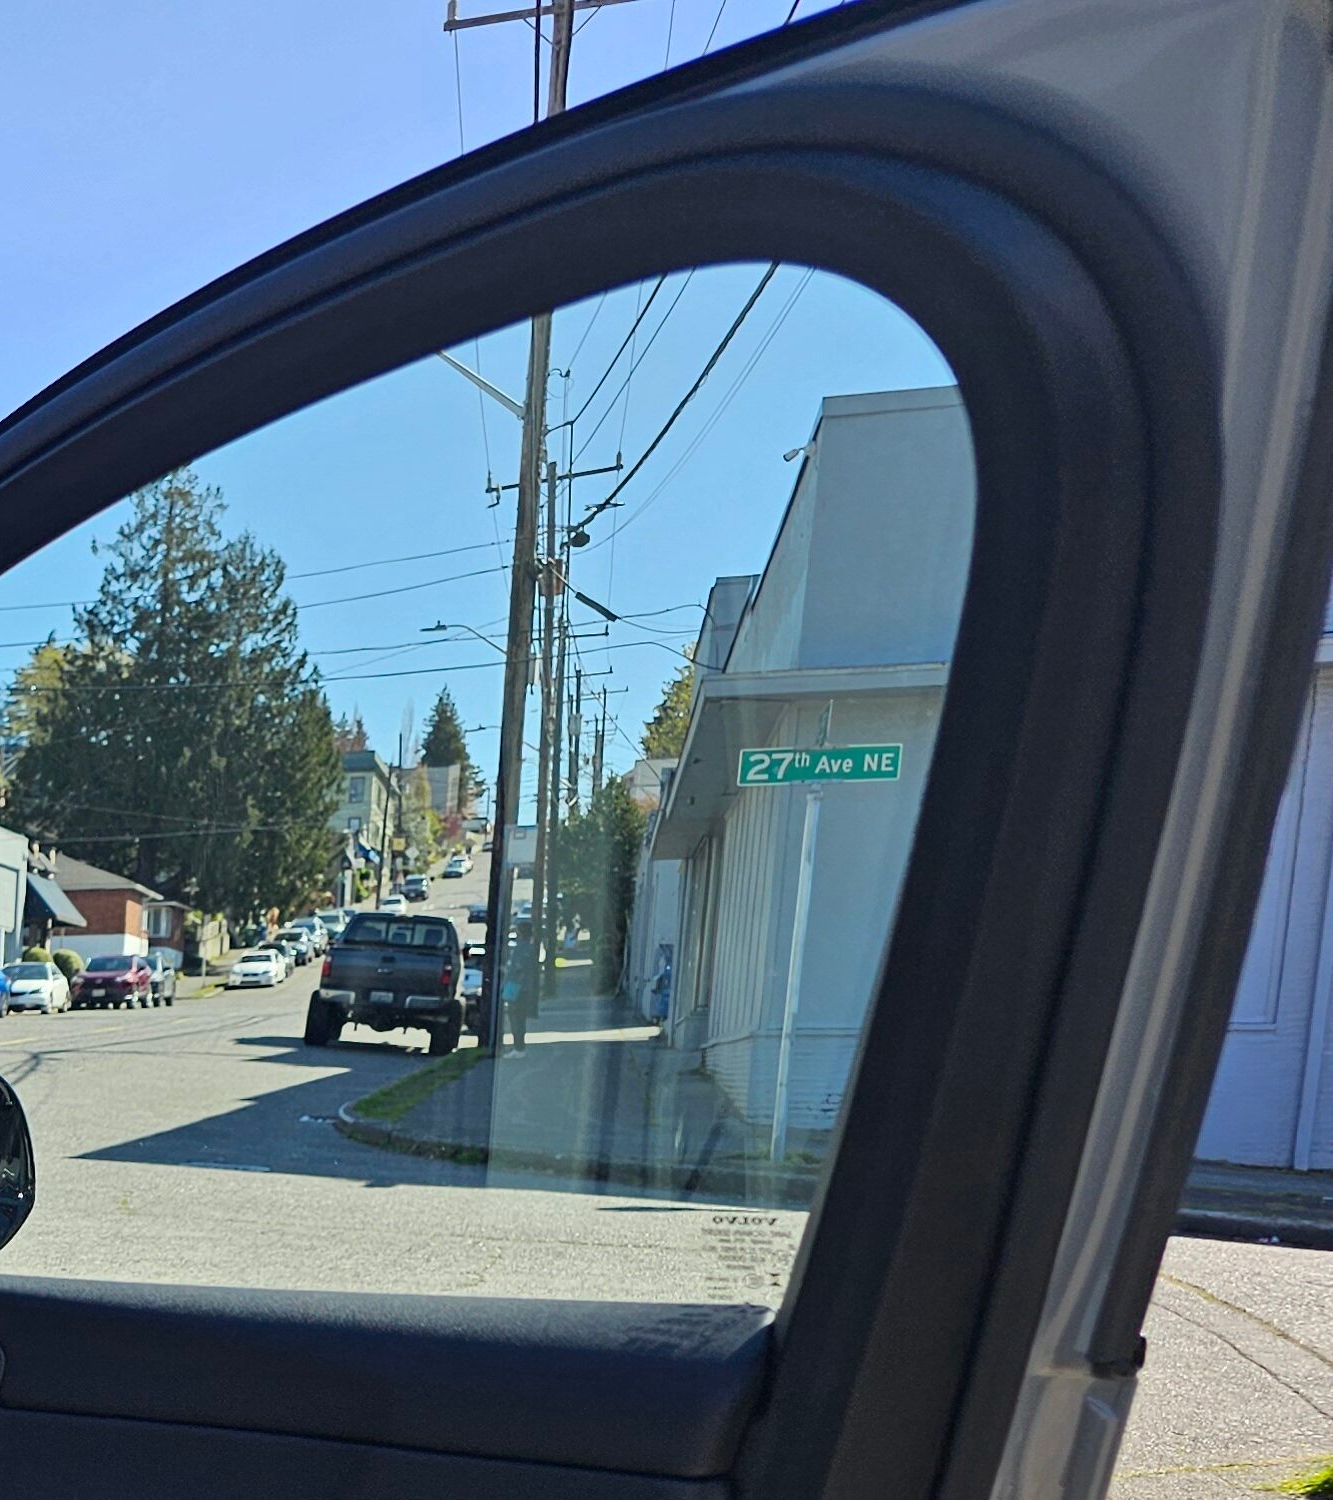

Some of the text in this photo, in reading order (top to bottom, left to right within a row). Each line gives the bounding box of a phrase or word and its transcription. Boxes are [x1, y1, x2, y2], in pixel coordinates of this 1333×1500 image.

[746, 752, 895, 781] 27th Ave NE
